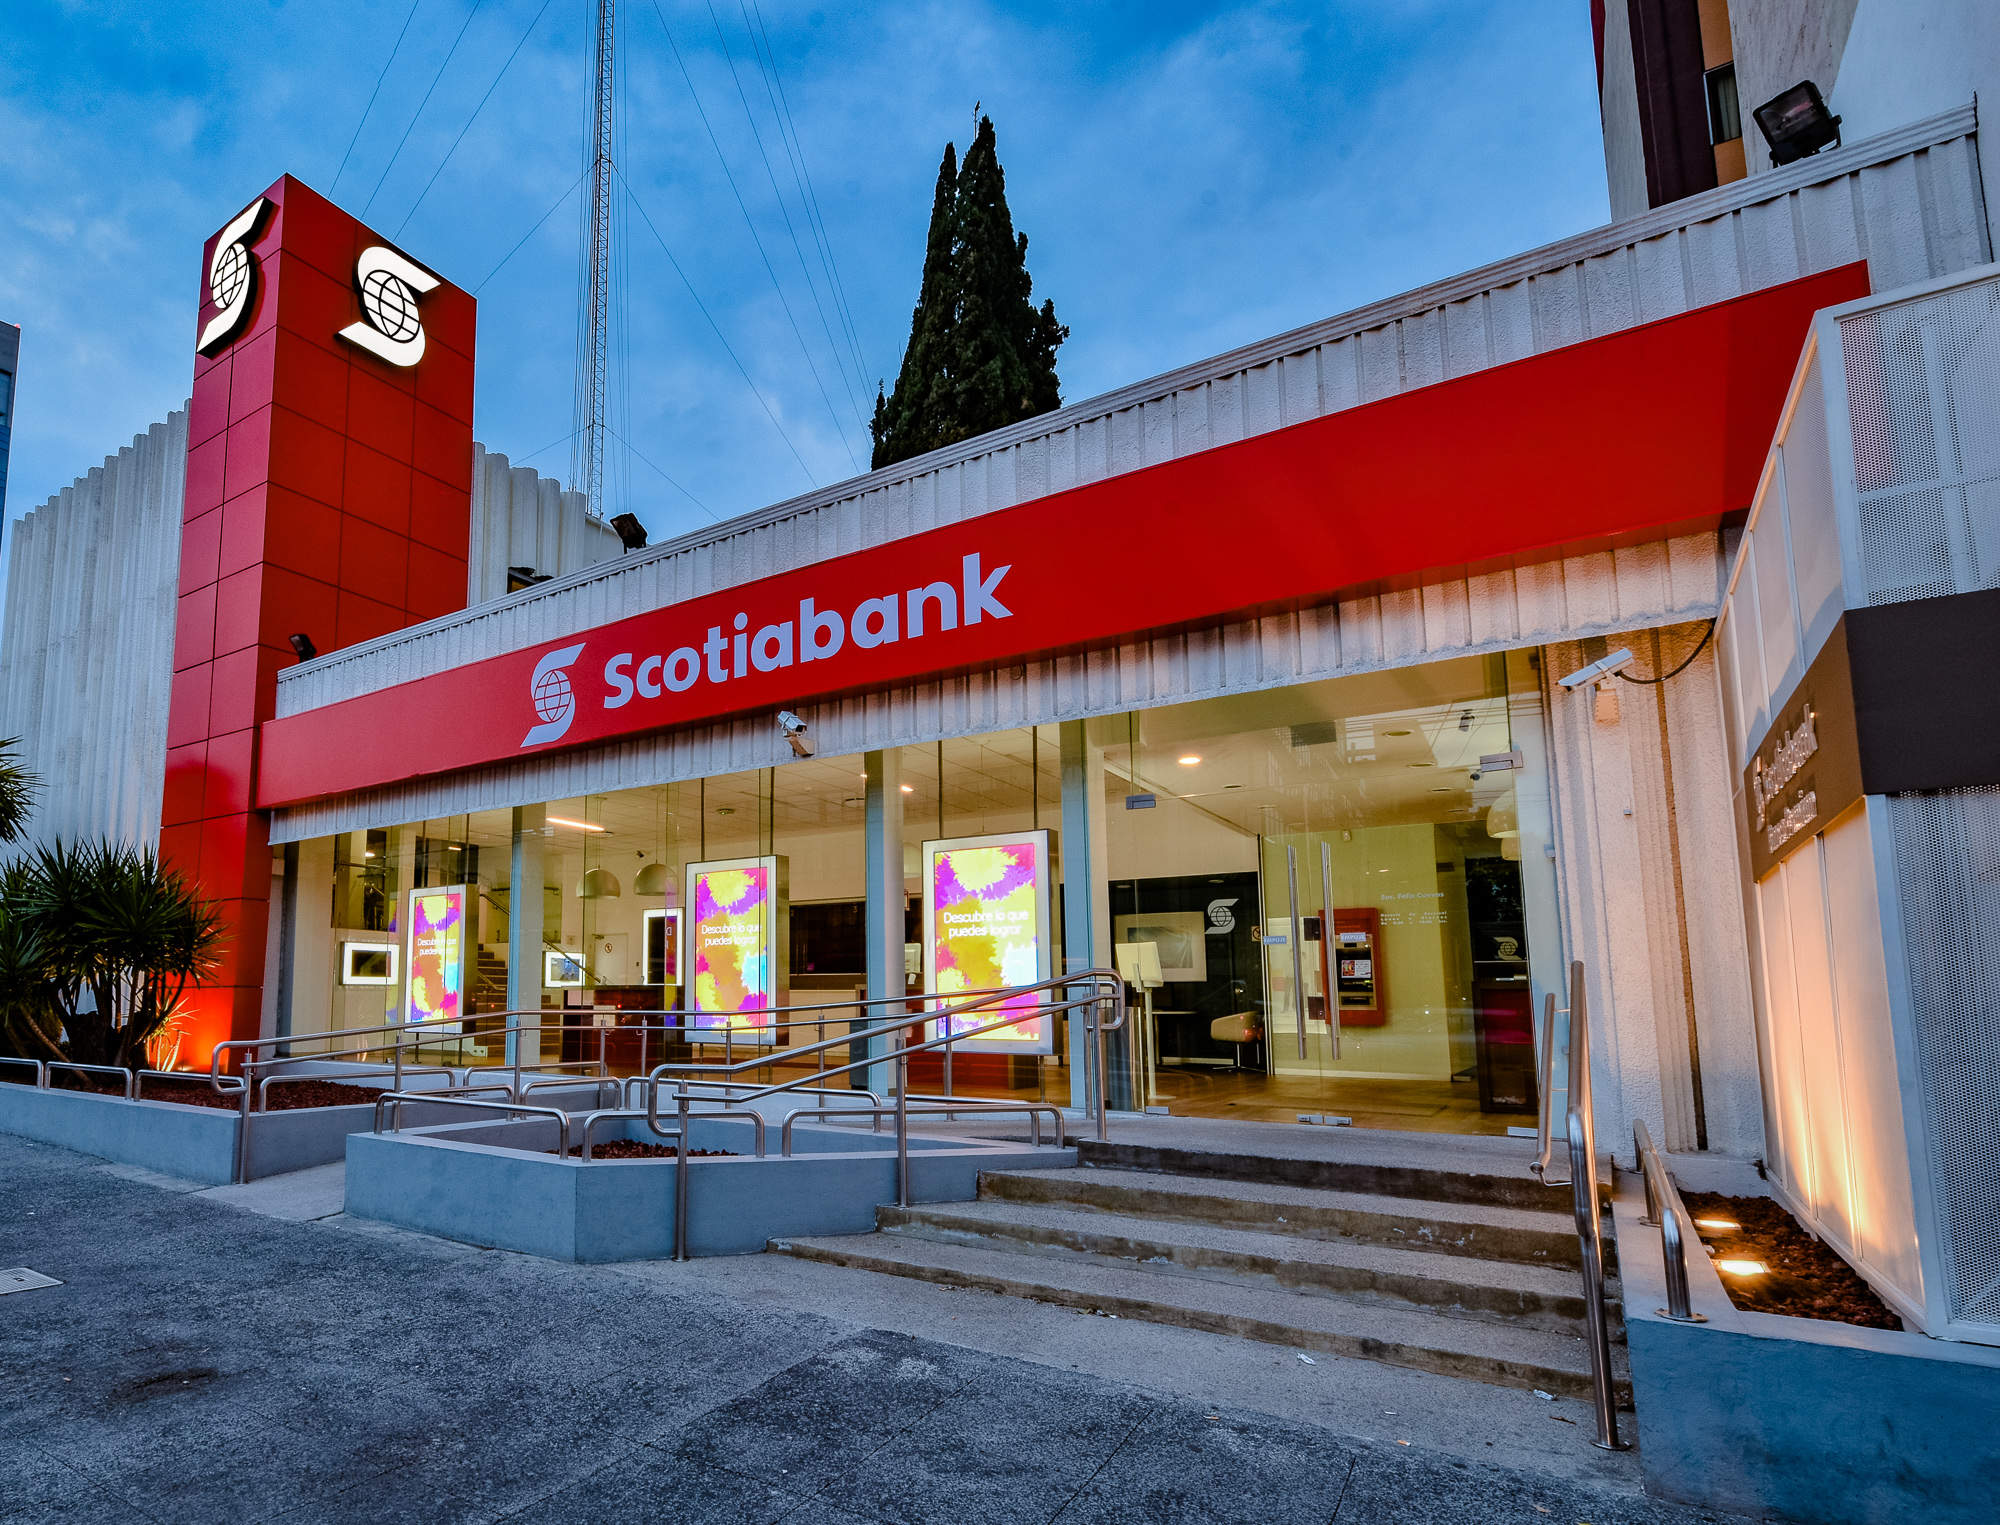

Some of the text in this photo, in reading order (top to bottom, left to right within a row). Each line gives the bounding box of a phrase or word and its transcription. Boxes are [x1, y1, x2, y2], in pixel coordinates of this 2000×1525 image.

[603, 552, 1014, 709] Scotiabank
[943, 907, 1029, 924] Descubre lo que
[701, 923, 736, 935] Descubre
[948, 922, 1021, 940] puedes lograr
[704, 936, 732, 948] puedes
